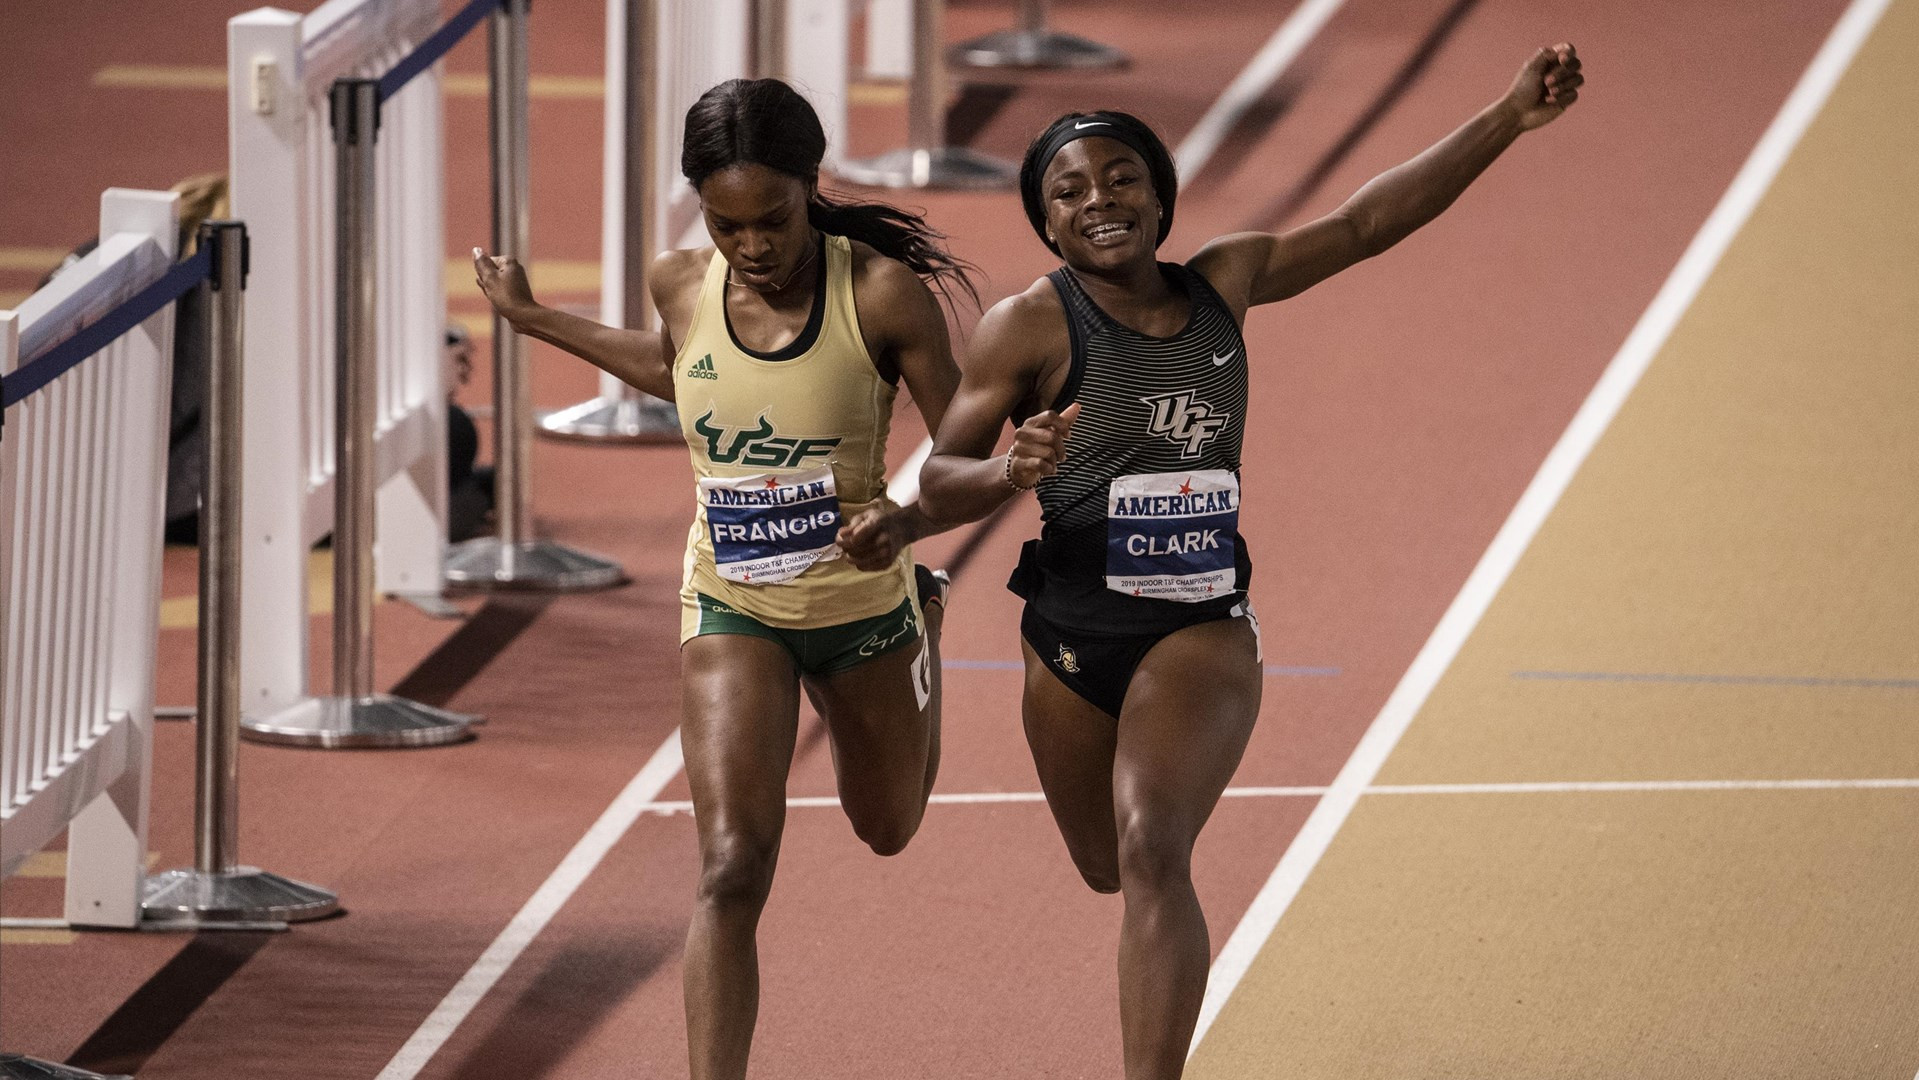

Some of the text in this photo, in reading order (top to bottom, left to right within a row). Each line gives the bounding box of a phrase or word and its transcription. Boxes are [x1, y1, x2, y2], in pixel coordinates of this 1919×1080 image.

[687, 368, 718, 380] adidas
[694, 403, 844, 468] USF
[1140, 390, 1229, 459] UCF
[708, 481, 827, 507] AMERICAN
[1114, 490, 1232, 516] AMERICAN
[1127, 528, 1222, 557] CLARK
[730, 565, 745, 574] 2019
[745, 562, 770, 572] INDOOR
[751, 568, 786, 578] BIRMINGHAM
[1137, 579, 1163, 587] INDOOR
[1175, 574, 1224, 586] CHAMPIONSHIPS
